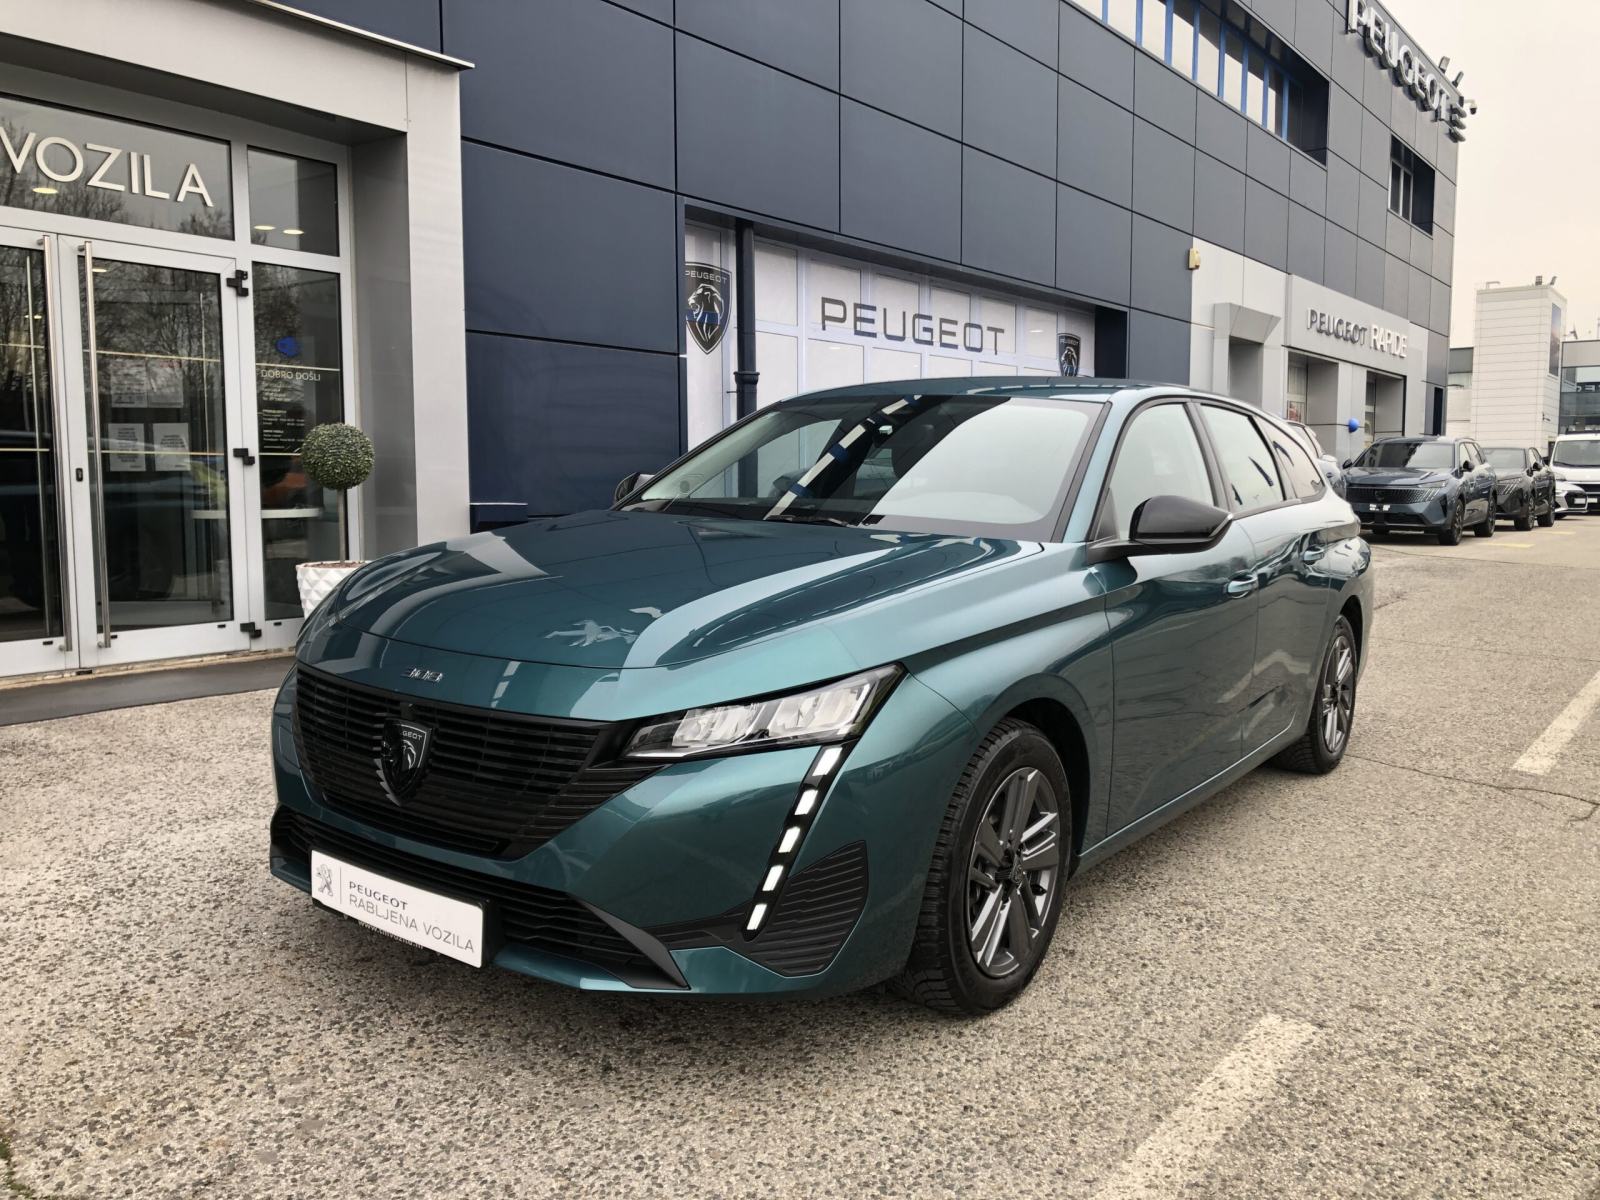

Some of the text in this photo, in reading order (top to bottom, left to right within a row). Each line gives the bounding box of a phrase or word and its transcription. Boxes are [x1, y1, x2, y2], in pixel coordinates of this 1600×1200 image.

[1346, 0, 1450, 121] PEUGEOT
[0, 126, 214, 208] VOZILA
[821, 296, 1005, 356] PEUGEOT
[1306, 308, 1368, 346] PEUGEOT
[260, 369, 321, 381] DOBRO DOŠLI
[349, 881, 408, 911] PEUGEOT
[349, 894, 419, 932] RABLJENA
[422, 921, 475, 953] VOZILA
